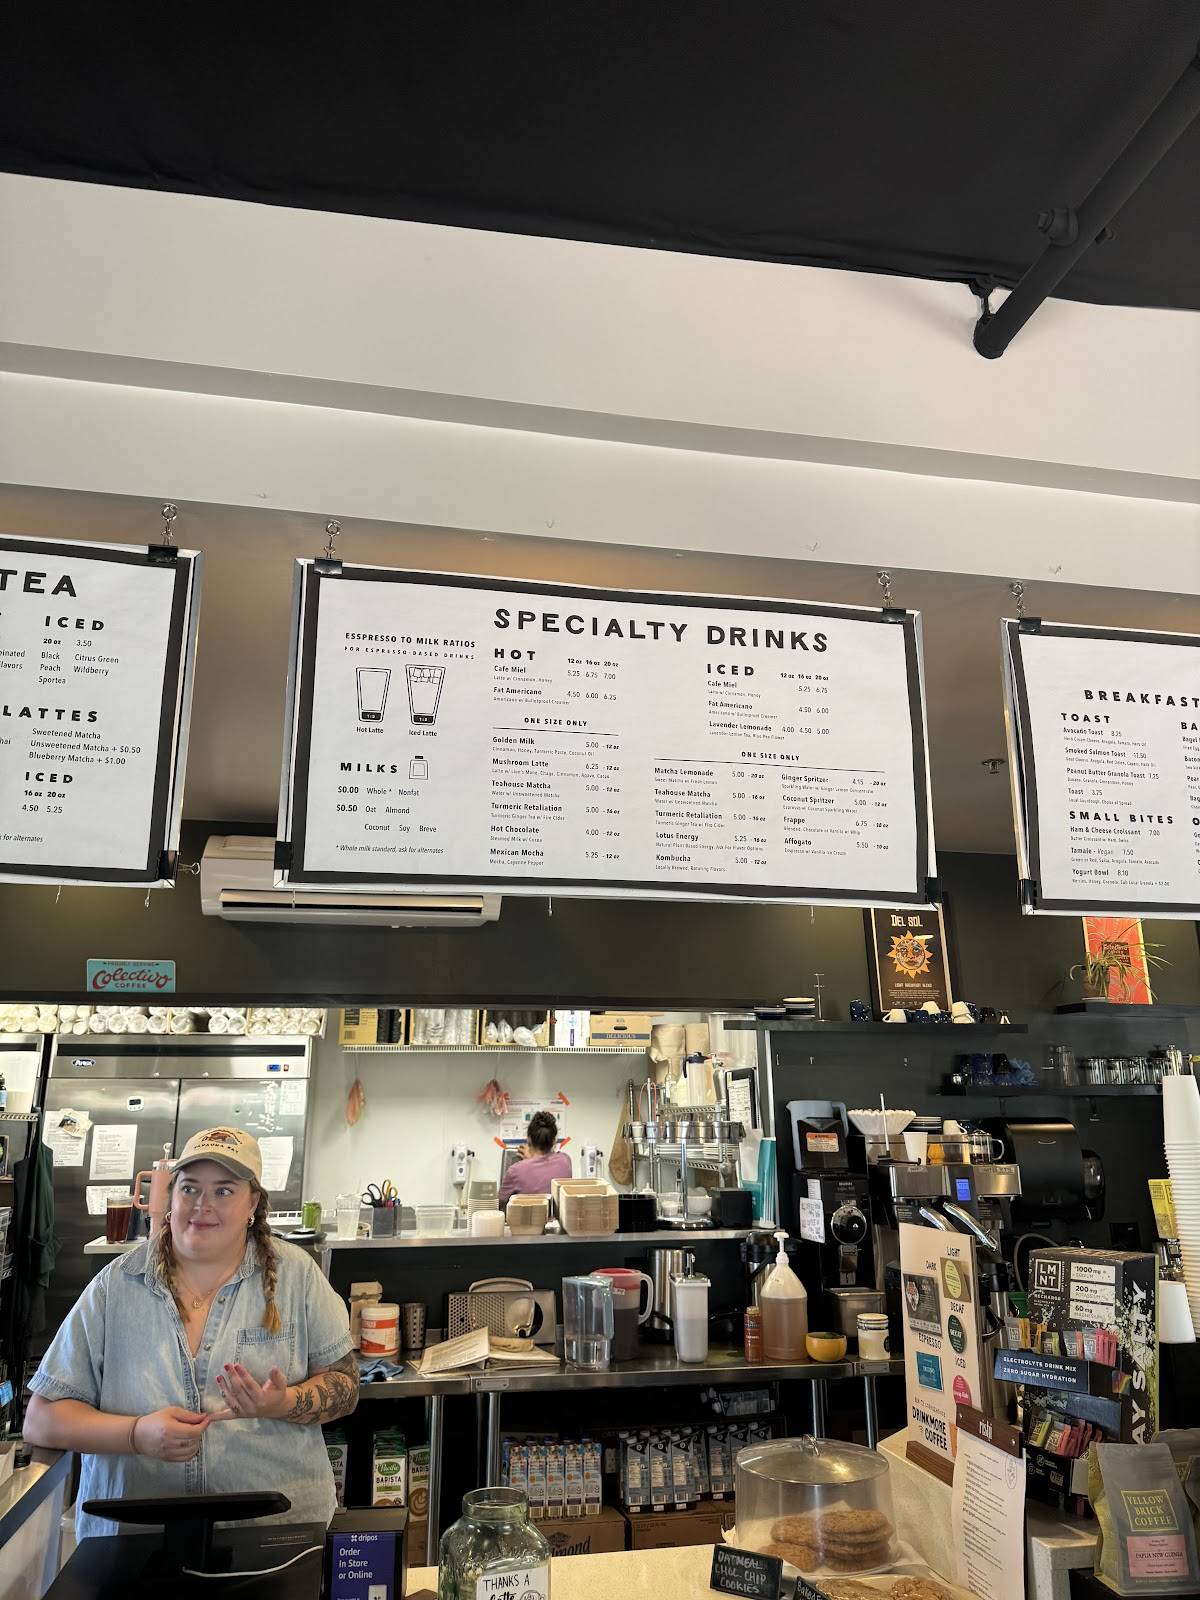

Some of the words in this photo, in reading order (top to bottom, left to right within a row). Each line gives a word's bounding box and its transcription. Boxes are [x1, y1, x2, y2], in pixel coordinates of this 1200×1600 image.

[0, 569, 77, 598] TEA
[45, 616, 104, 631] ICED
[493, 608, 688, 642] SPECIALTY
[707, 625, 829, 653] DRINKS
[345, 633, 397, 643] ESSPRESSO
[416, 638, 439, 646] MILK
[443, 640, 476, 648] RATIOS
[41, 652, 60, 660] Black
[74, 654, 96, 662] Citrus
[97, 656, 119, 664] Green
[494, 648, 536, 661] HOT
[40, 664, 61, 672] Peach
[73, 666, 109, 676] Wildberry
[494, 665, 509, 673] Cafe
[511, 666, 526, 674] Miel
[707, 663, 754, 676] ICED
[38, 676, 66, 685] Sportea
[604, 693, 617, 701] 6.25
[1084, 689, 1200, 708] BREAKFAST
[719, 702, 753, 710] Americano
[2, 705, 98, 722] LATTES
[1061, 713, 1111, 724] TOAST
[566, 719, 588, 727] ONLY
[709, 721, 738, 729] Lavender
[740, 724, 772, 732] Lemonade
[32, 728, 73, 738] Sweetened
[74, 731, 101, 740] Matcha
[30, 740, 81, 750] Unsweetened
[83, 744, 109, 752] Matcha
[119, 746, 141, 754] $0.50
[1065, 747, 1088, 755] Smoked
[1088, 749, 1110, 757] Salmon
[29, 752, 66, 763] Blueberry
[67, 755, 94, 763] Matcha
[104, 757, 126, 765] $1.00
[760, 752, 777, 760] SIZE
[492, 758, 530, 766] Mushroom
[340, 762, 398, 774] MILKS
[654, 767, 678, 775] Matcha
[25, 772, 73, 784] ICED
[781, 774, 803, 783] Ginger
[492, 780, 524, 788] Teahouse
[337, 786, 359, 794] $0.00
[398, 789, 420, 797] Nonfat
[654, 788, 686, 796] Teahouse
[687, 790, 711, 798] Matcha
[782, 795, 808, 803] Coconut
[809, 796, 834, 805] Spritzer
[22, 804, 39, 812] 4.50
[46, 806, 63, 814] 5.25
[336, 804, 358, 812] $0.50
[365, 805, 377, 813] Oat
[385, 806, 410, 814] Almond
[491, 802, 522, 810] Turmeric
[523, 804, 562, 812] Retaliation
[655, 810, 684, 818] Turmeric
[686, 811, 723, 819] Retaliation
[1069, 811, 1120, 822] SMALL
[1129, 814, 1174, 824] BITES
[783, 816, 806, 825] Frappe
[399, 825, 411, 833] Soy
[419, 825, 437, 833] Breve
[1091, 827, 1112, 835] Cheese
[1113, 828, 1141, 836] Croissant
[676, 832, 699, 842] Energy
[784, 838, 812, 847] Affogato
[490, 848, 519, 856] Mexican
[521, 849, 544, 857] Mocha
[655, 854, 691, 862] Kombucha
[1072, 869, 1093, 877] Yogurt
[891, 914, 907, 927] DEL
[908, 914, 923, 927] SOL
[92, 967, 172, 989] Colectivo
[1075, 1265, 1093, 1273] 1000
[919, 1332, 942, 1350] ESPRESSO
[1003, 1356, 1043, 1367] ELECTROLYTE
[1044, 1363, 1064, 1372] DRINK
[1003, 1367, 1019, 1375] ZERO
[1020, 1369, 1040, 1378] SUGAR
[1041, 1373, 1077, 1383] HYDRATION
[924, 1427, 948, 1451] COFFEE
[376, 1475, 402, 1484] BARISTA
[1127, 1494, 1164, 1505] YELLOW
[1134, 1505, 1164, 1515] BRICK
[1134, 1516, 1173, 1526] COFFEE
[358, 1534, 378, 1543] dripos
[339, 1547, 361, 1556] Order
[348, 1559, 369, 1568] Store
[718, 1551, 764, 1570] OATMEAL
[348, 1570, 373, 1579] Online
[744, 1570, 767, 1585] CHIP
[483, 1574, 519, 1592] THANKS
[524, 1573, 530, 1586] A
[720, 1577, 760, 1594] COOKIES
